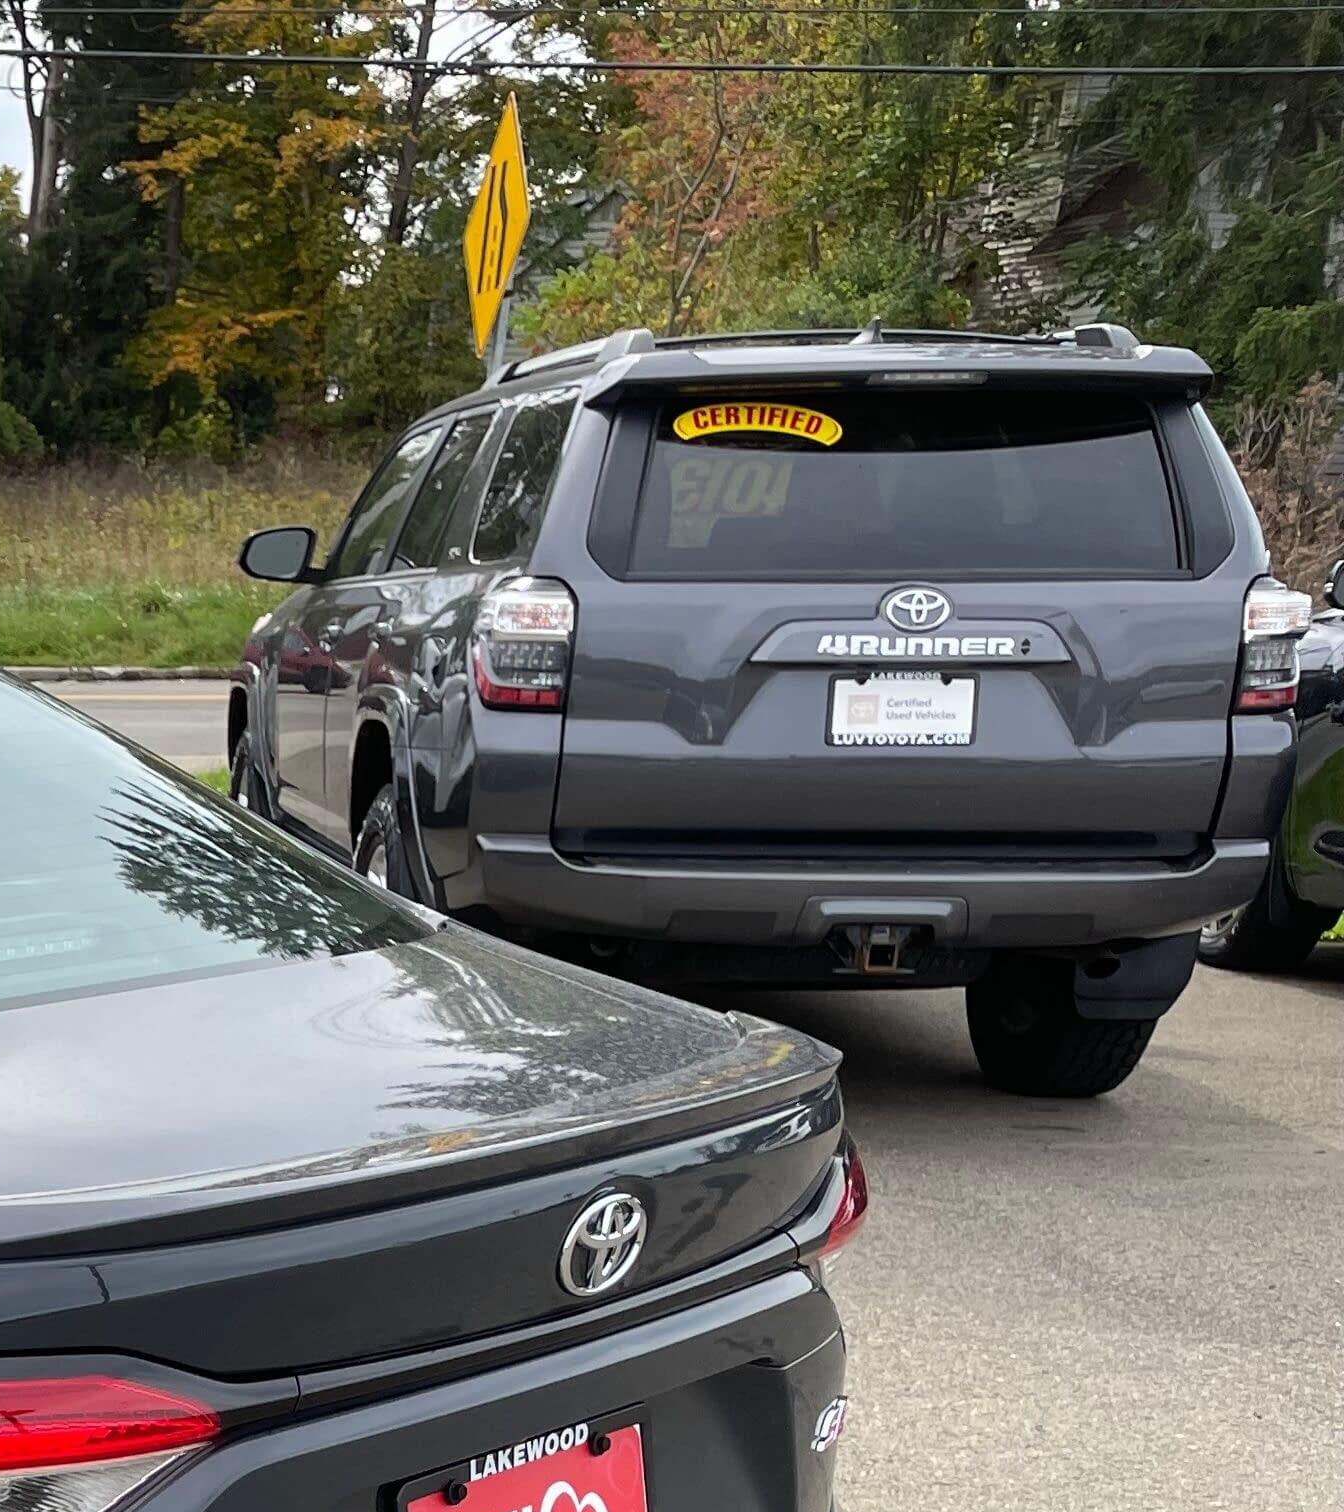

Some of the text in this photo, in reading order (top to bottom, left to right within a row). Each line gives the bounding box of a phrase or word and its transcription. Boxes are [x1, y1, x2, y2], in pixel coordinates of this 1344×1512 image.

[692, 405, 823, 435] CERTIFIED
[817, 635, 1015, 656] 4RUNNER
[870, 671, 942, 681] LAKEWOOD
[886, 697, 932, 708] Certified
[886, 710, 957, 720] Used Vehicles
[833, 733, 971, 745] LUVTOYOTA.COM
[469, 1423, 589, 1482] LAKEWOOD
